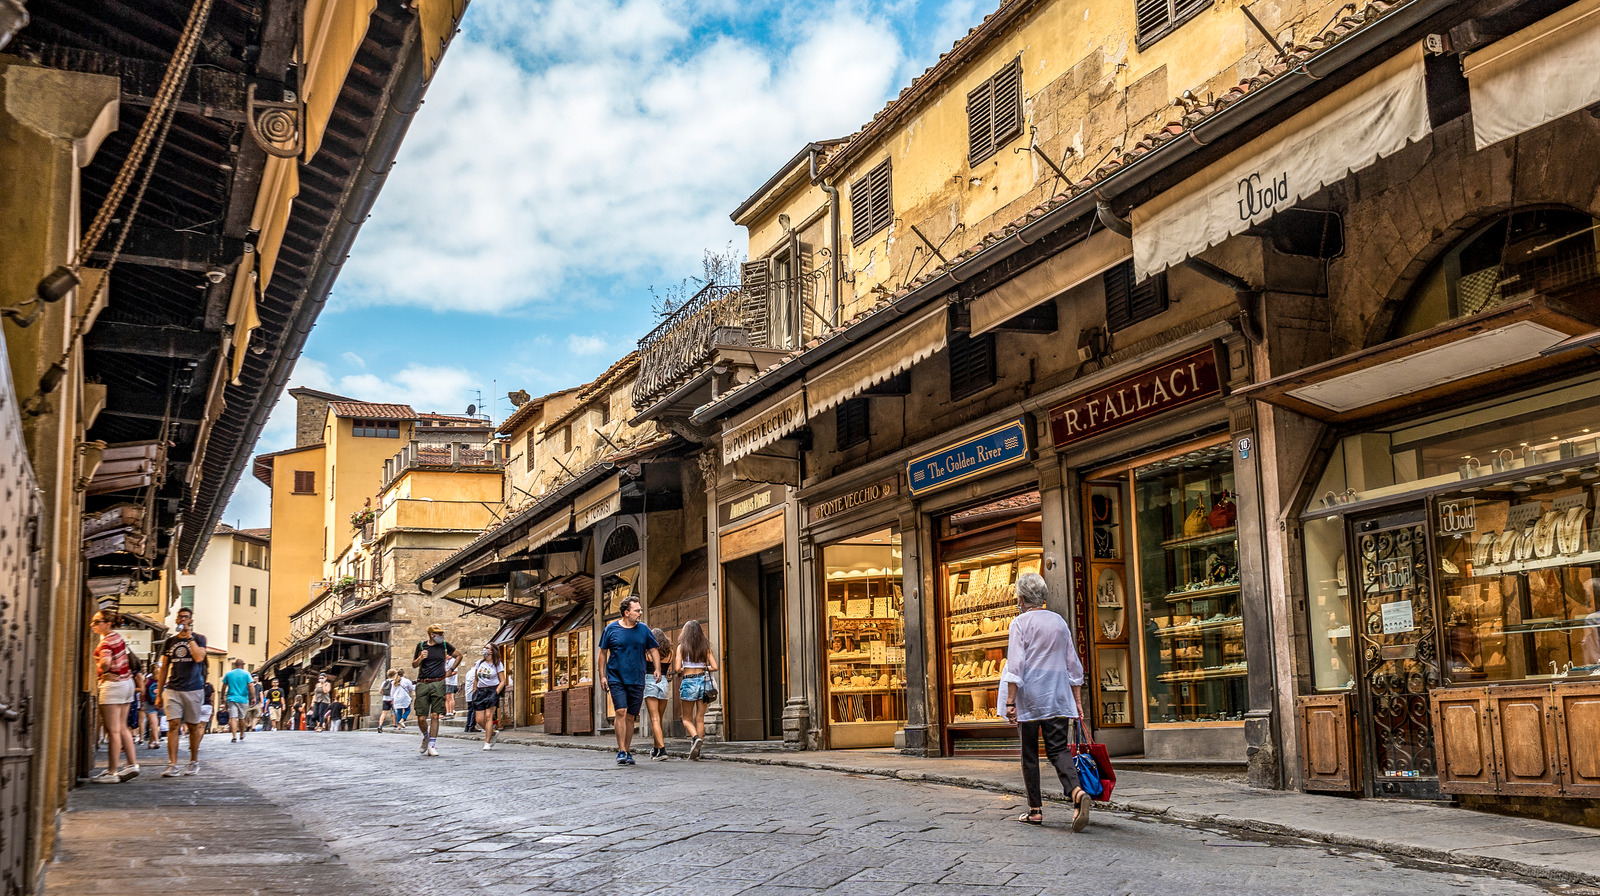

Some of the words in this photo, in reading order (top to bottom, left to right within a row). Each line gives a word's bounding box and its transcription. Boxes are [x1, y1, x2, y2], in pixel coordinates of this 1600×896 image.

[927, 461, 945, 479] The
[945, 451, 976, 473] Golden
[976, 444, 1002, 464] River
